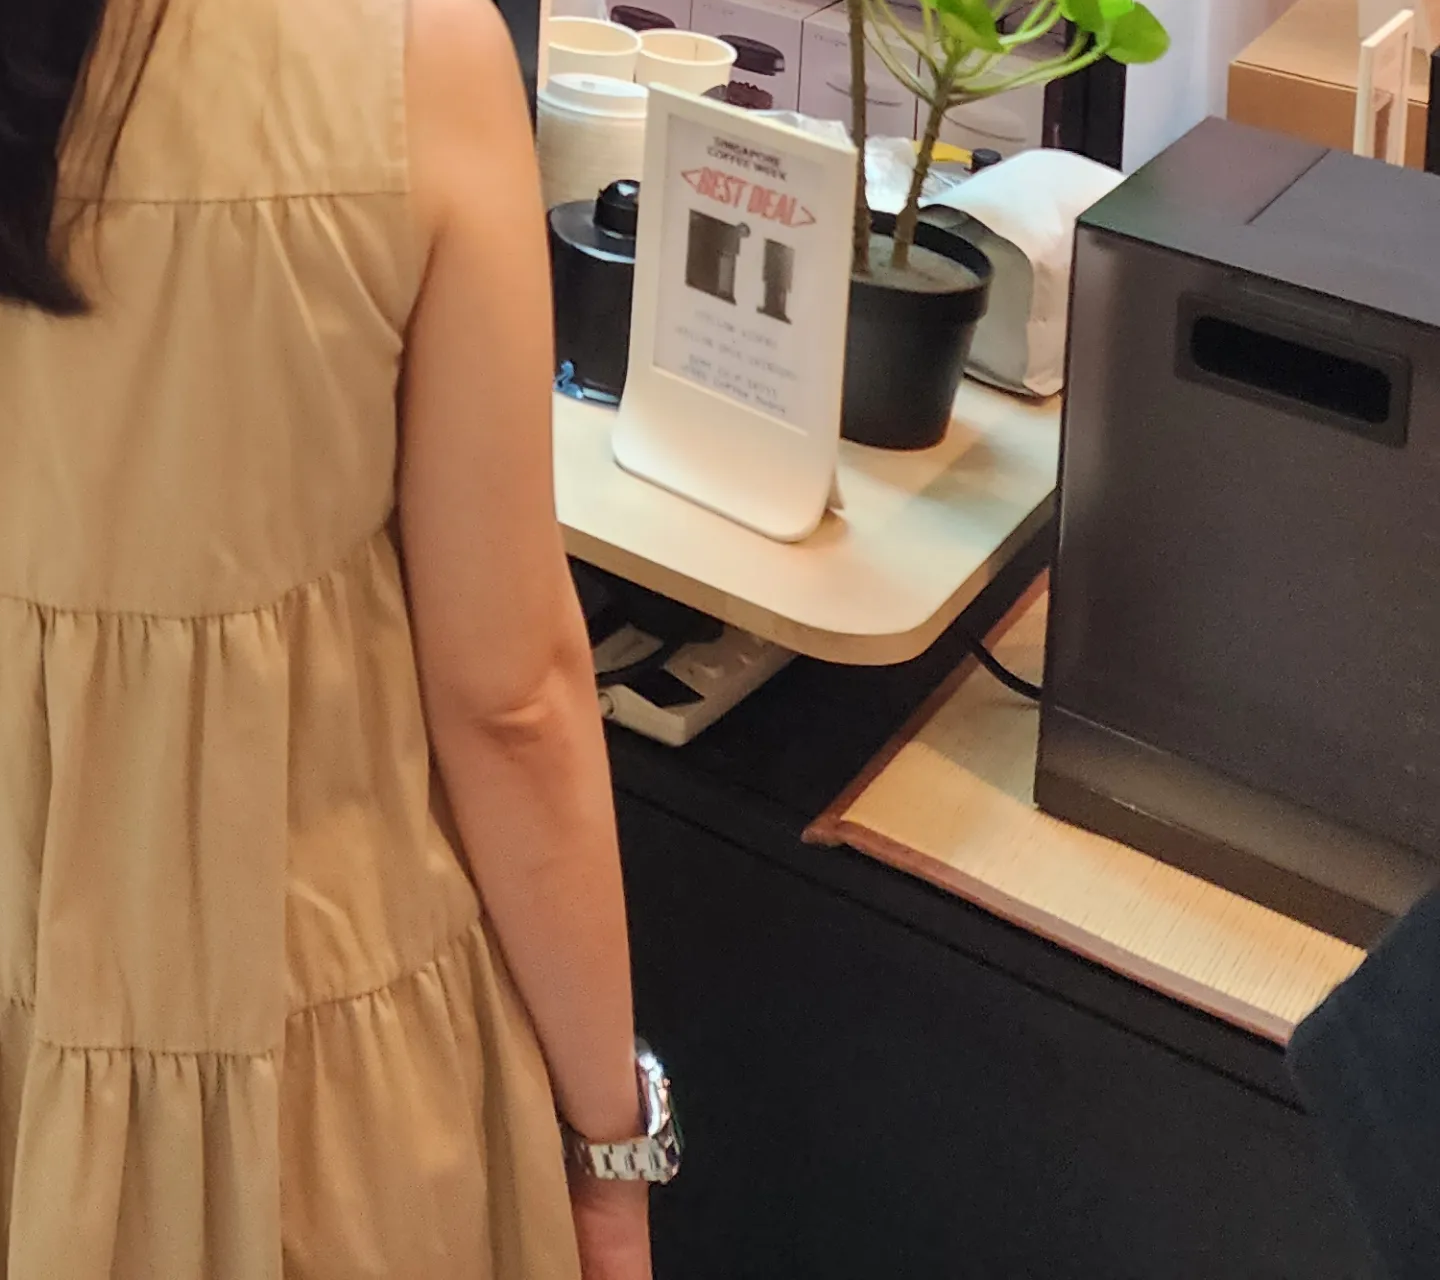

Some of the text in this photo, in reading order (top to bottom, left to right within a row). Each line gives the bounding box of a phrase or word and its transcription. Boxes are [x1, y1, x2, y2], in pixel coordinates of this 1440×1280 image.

[706, 145, 787, 183] COFFEE WEEK
[713, 135, 781, 167] SINGAPORE
